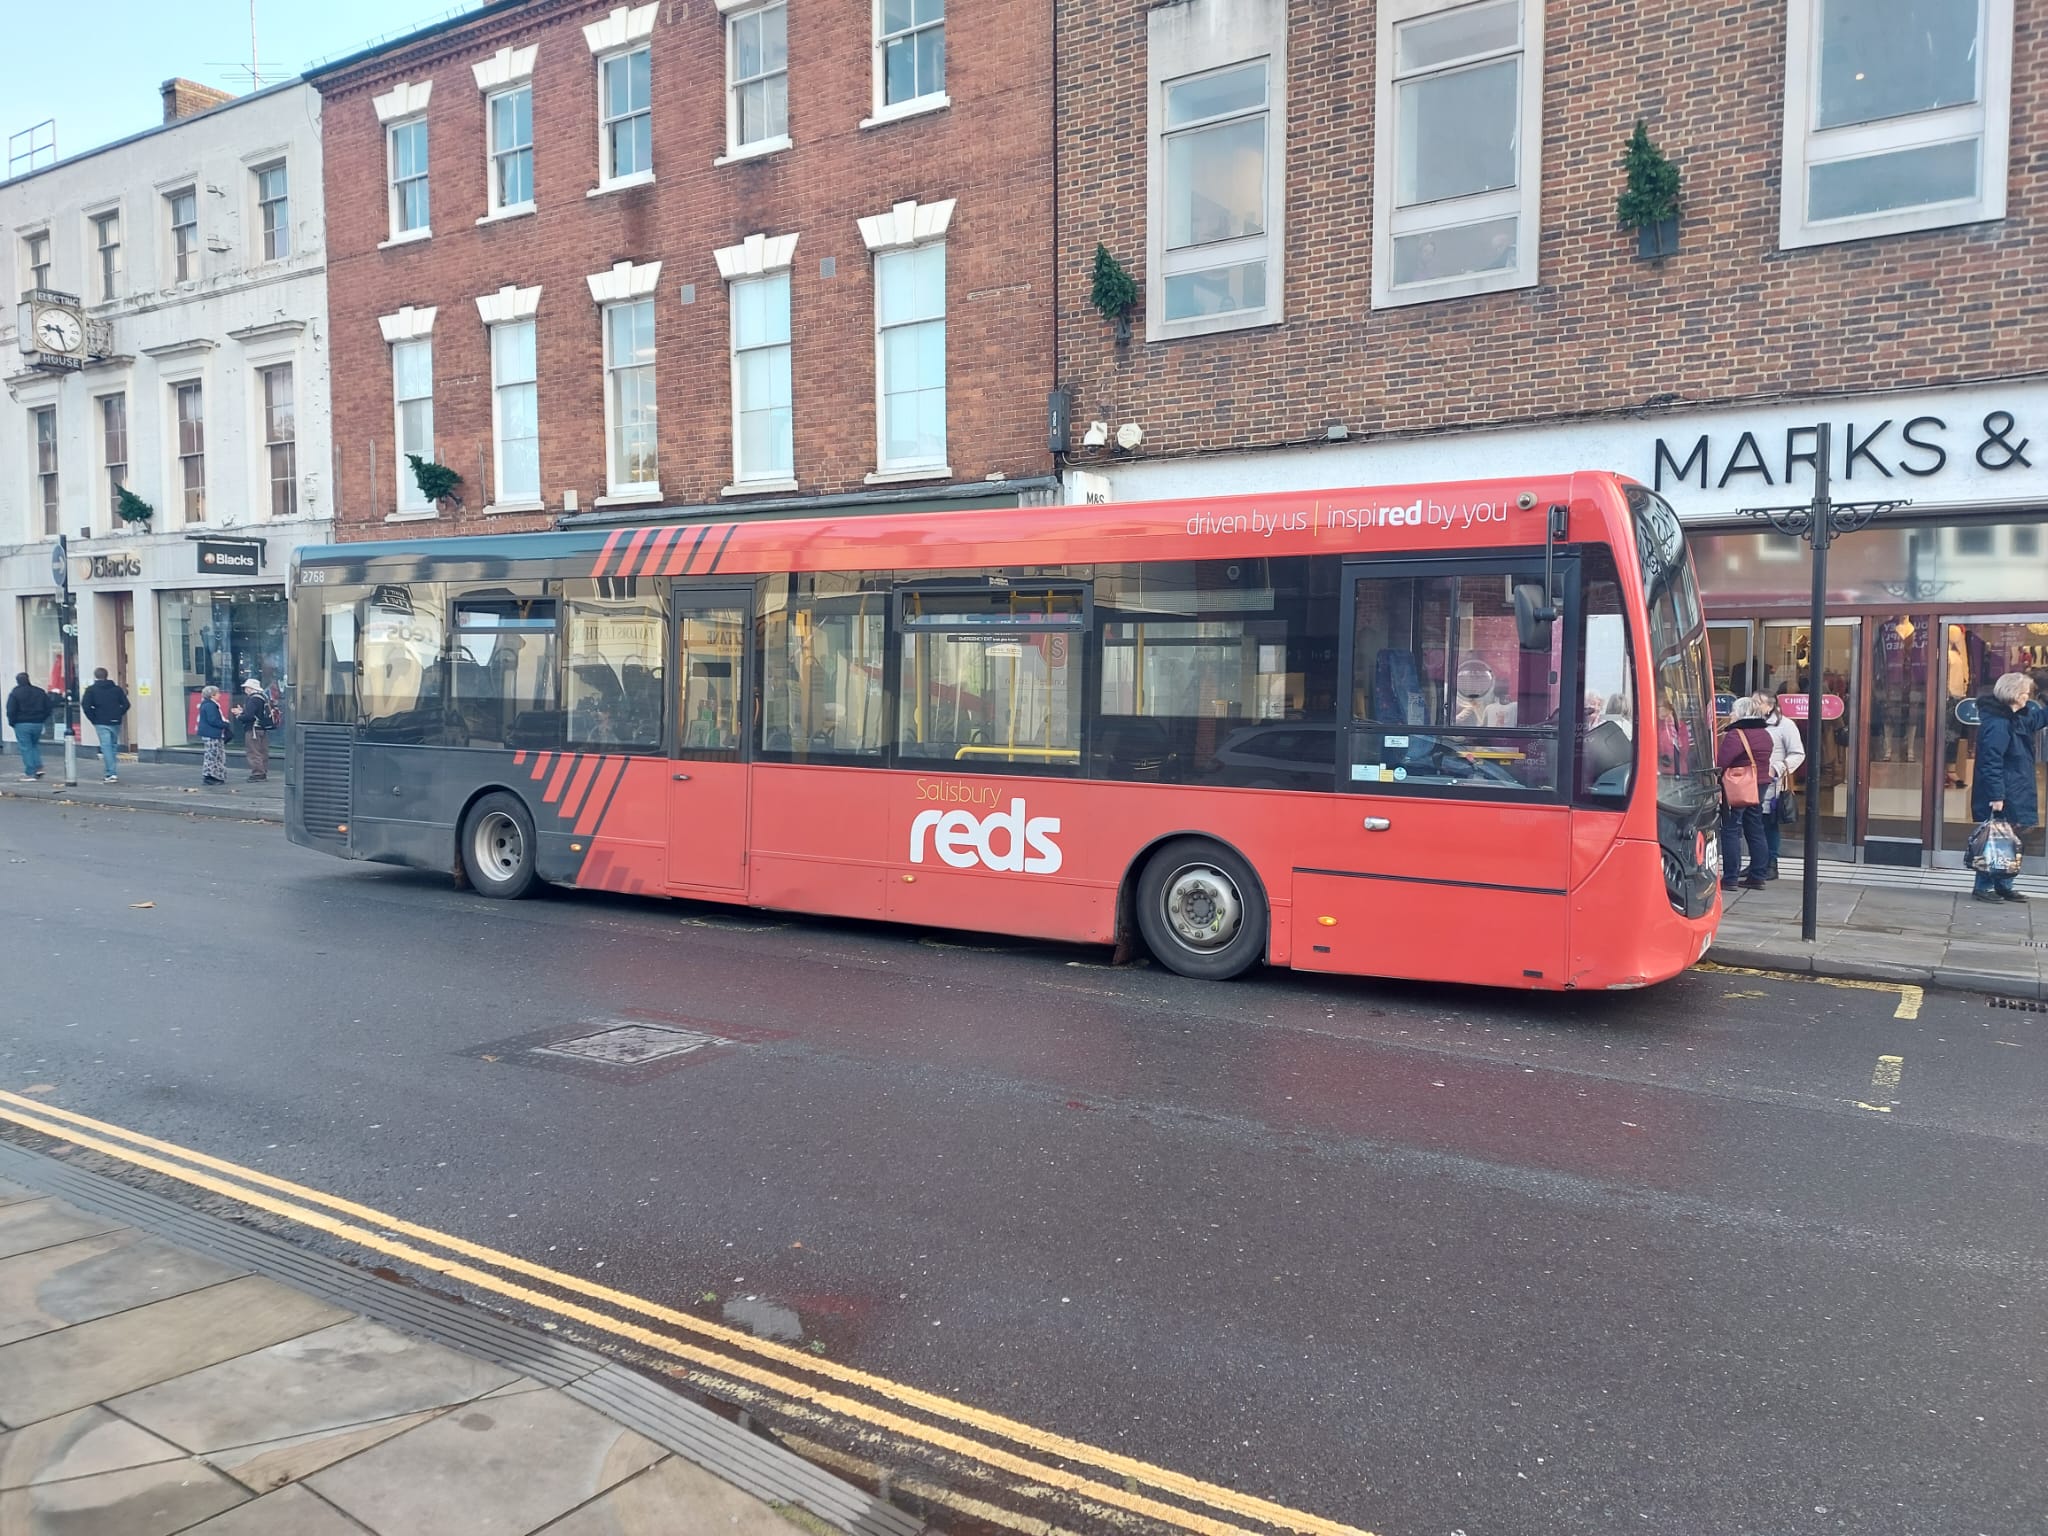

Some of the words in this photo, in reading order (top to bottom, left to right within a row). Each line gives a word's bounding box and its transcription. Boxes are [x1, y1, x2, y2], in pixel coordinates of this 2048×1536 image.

[42, 353, 80, 367] HOUSE
[1654, 416, 1947, 492] MARKS
[1975, 410, 2032, 471] &
[1086, 491, 1105, 504] M&S
[1186, 512, 1247, 536] driven
[1251, 508, 1278, 538] by
[1282, 512, 1307, 530] us
[1327, 500, 1422, 533] inspired
[1427, 499, 1454, 530] by
[1461, 501, 1508, 529] you
[93, 555, 142, 578] Blacks
[216, 553, 255, 567] Blacks
[302, 570, 325, 583] 2768
[915, 778, 1002, 808] Salisbury
[909, 797, 1063, 874] reds
